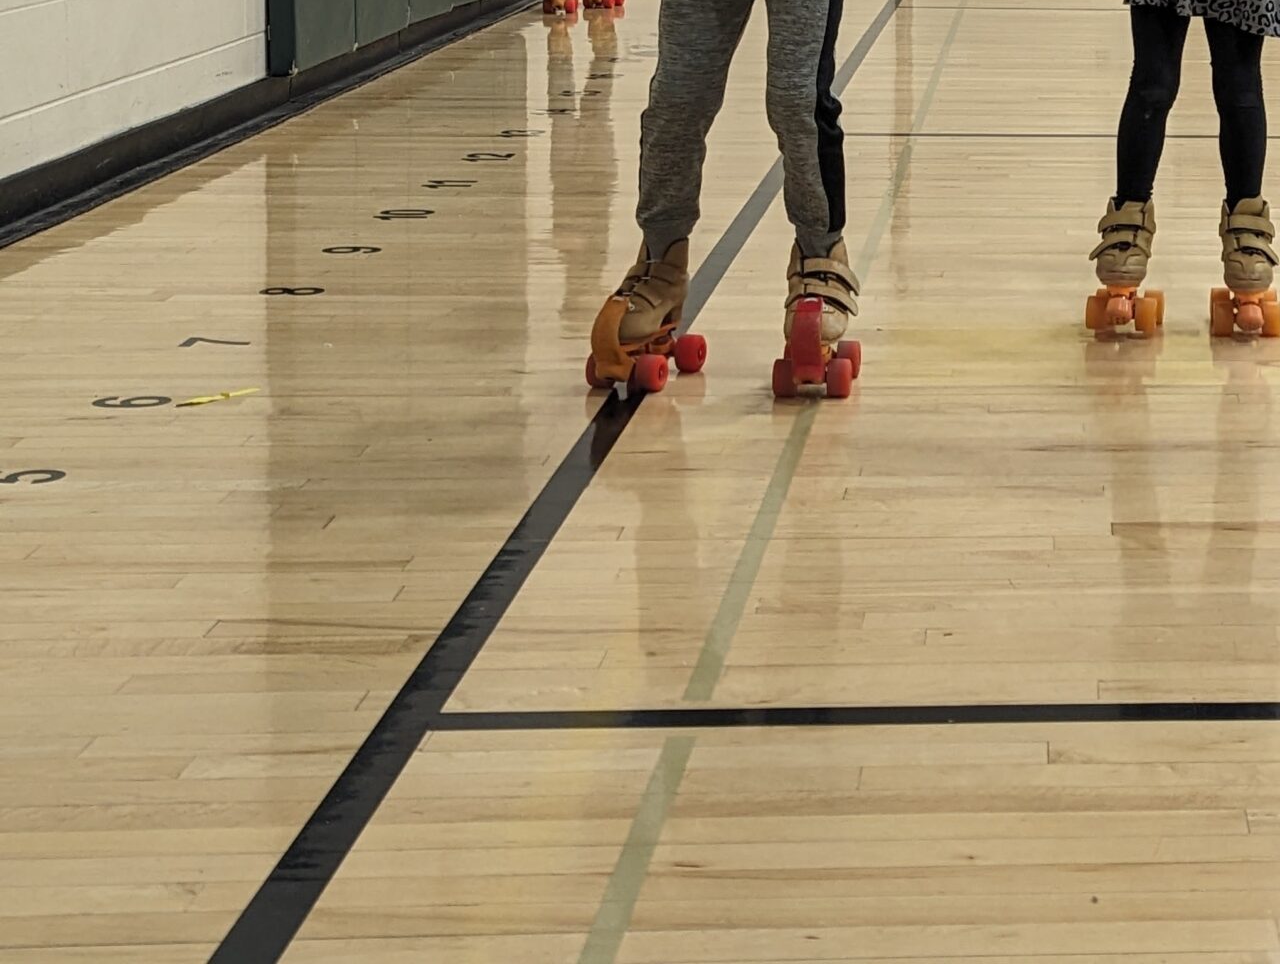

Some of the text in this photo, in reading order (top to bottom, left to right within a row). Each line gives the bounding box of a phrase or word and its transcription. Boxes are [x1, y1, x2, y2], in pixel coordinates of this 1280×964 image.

[461, 152, 516, 162] 12
[421, 180, 478, 189] 11
[373, 208, 435, 221] 10
[322, 245, 382, 254] 9
[258, 286, 325, 296] 8
[177, 336, 251, 348] 7
[91, 395, 172, 408] 6
